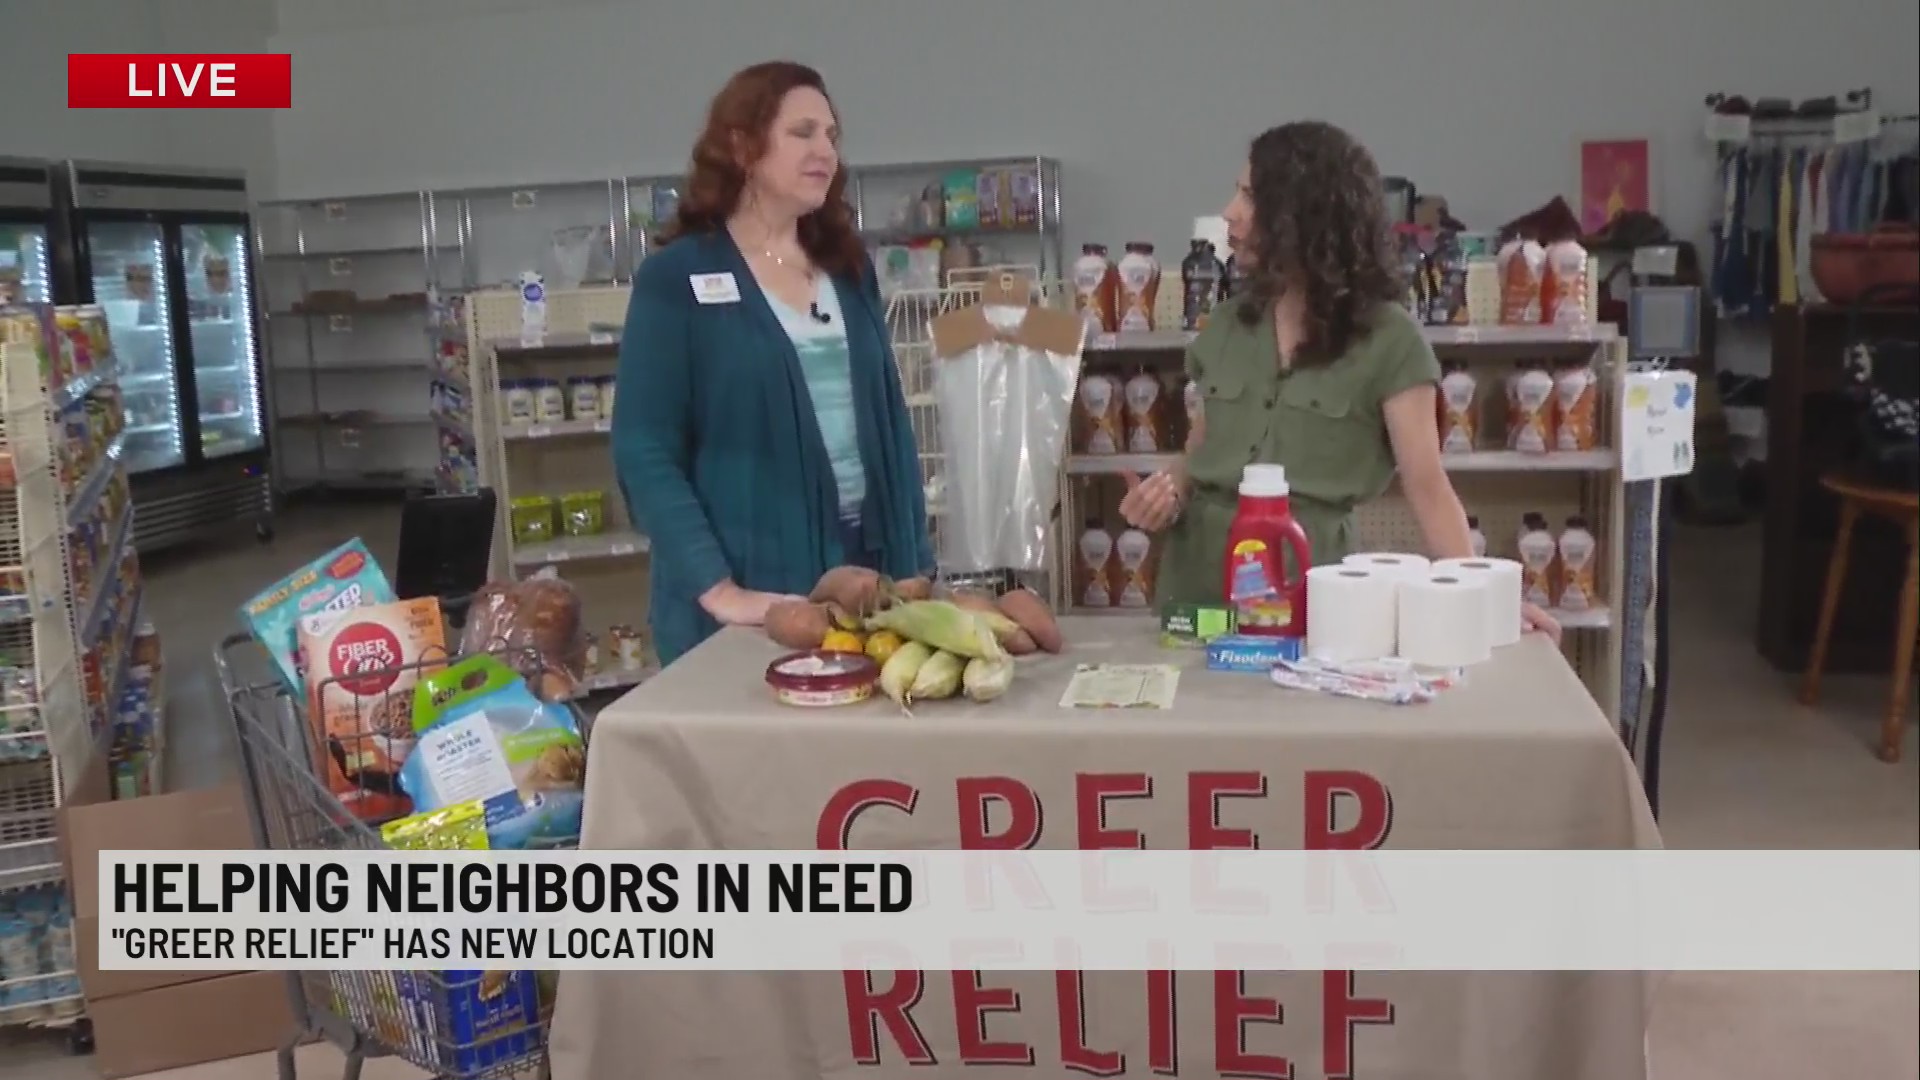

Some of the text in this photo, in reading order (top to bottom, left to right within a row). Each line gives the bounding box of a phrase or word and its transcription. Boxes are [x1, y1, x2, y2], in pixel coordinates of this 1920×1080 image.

[336, 638, 389, 661] FIBER
[1219, 649, 1284, 664] Fixodent
[815, 770, 1396, 915] GREER
[838, 936, 1404, 1079] RELIEF
